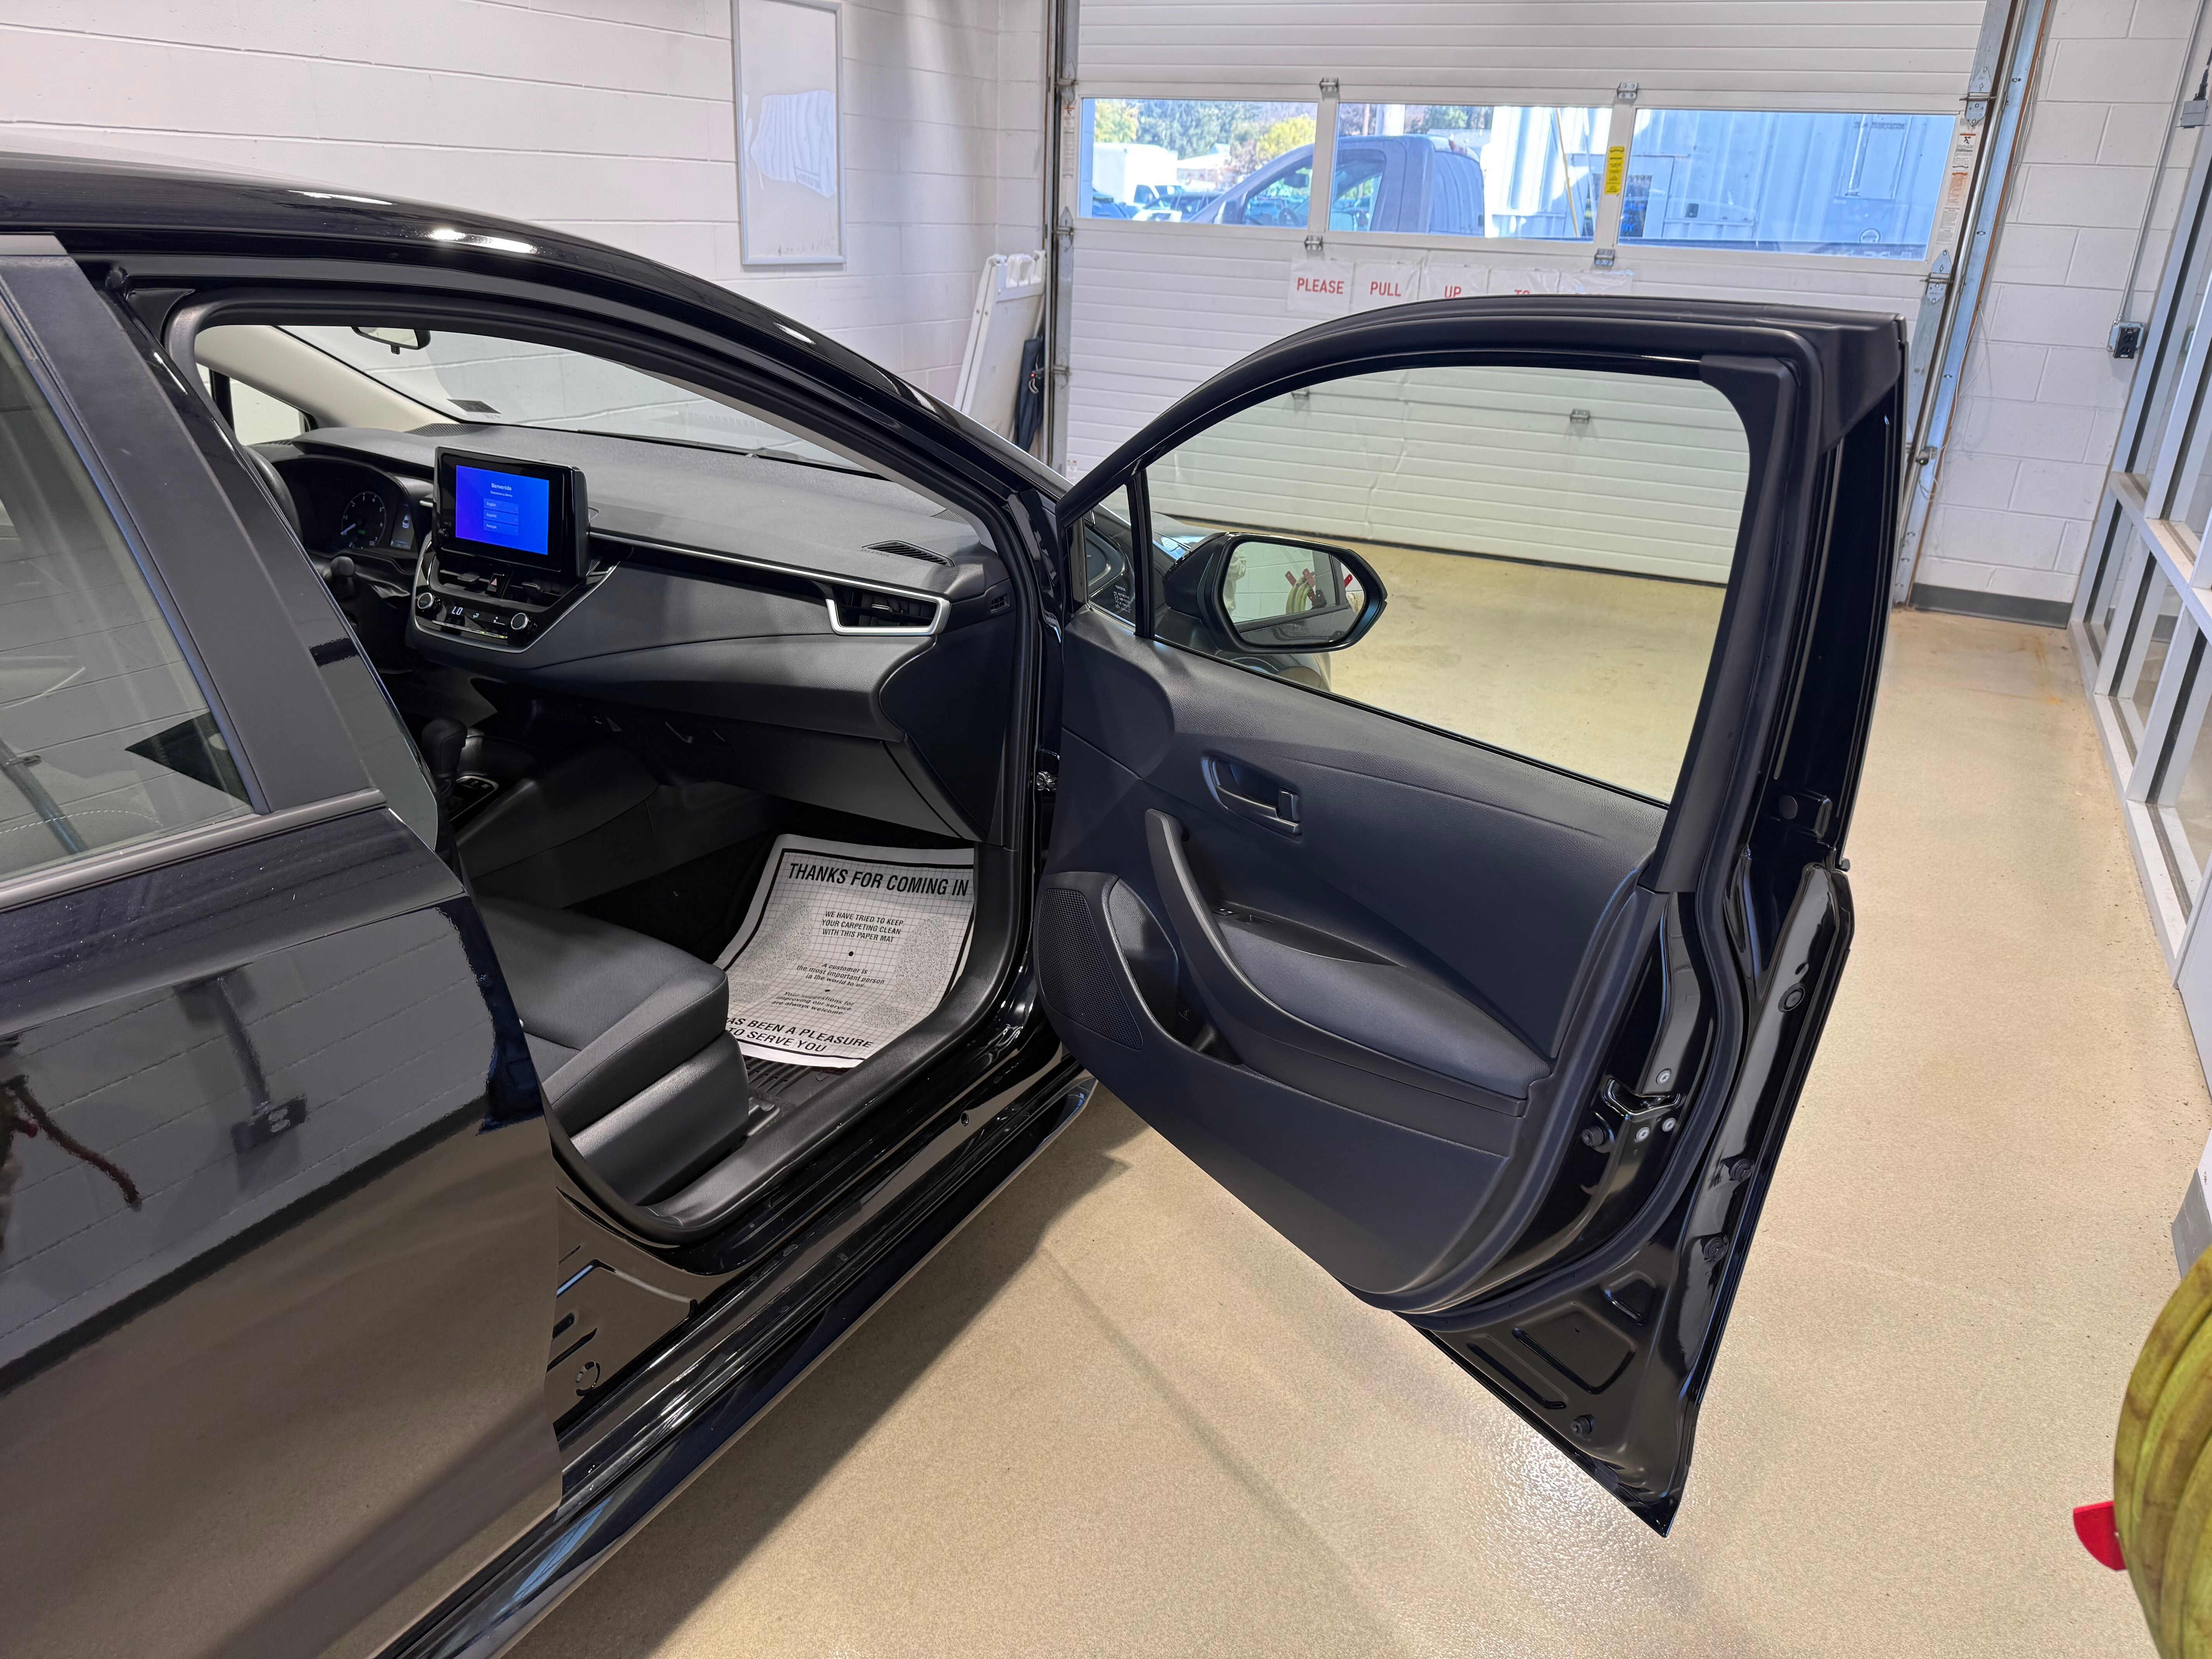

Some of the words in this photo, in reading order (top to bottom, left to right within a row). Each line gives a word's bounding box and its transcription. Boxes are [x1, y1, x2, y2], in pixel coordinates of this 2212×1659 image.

[1297, 277, 1345, 294] PLEASE
[1370, 281, 1401, 297] PULL
[1445, 285, 1462, 298] UP
[789, 863, 848, 884] THANKS
[850, 871, 883, 888] FOR
[886, 875, 948, 895] COMING
[952, 879, 969, 896] IN
[856, 914, 875, 922] TRIED
[841, 921, 878, 932] CARPETING
[879, 926, 901, 934] CLEAN
[857, 932, 879, 940] PAPER
[829, 964, 860, 974] customer
[827, 970, 861, 981] important
[776, 996, 811, 1004] improving
[801, 994, 843, 1004] suggestions
[811, 1006, 844, 1015] welcome.
[747, 1020, 785, 1032] BEEN
[799, 1029, 874, 1048] PLEASURE
[729, 1027, 745, 1036] TO
[747, 1031, 795, 1046] SERVE
[797, 1040, 828, 1053] YOU
